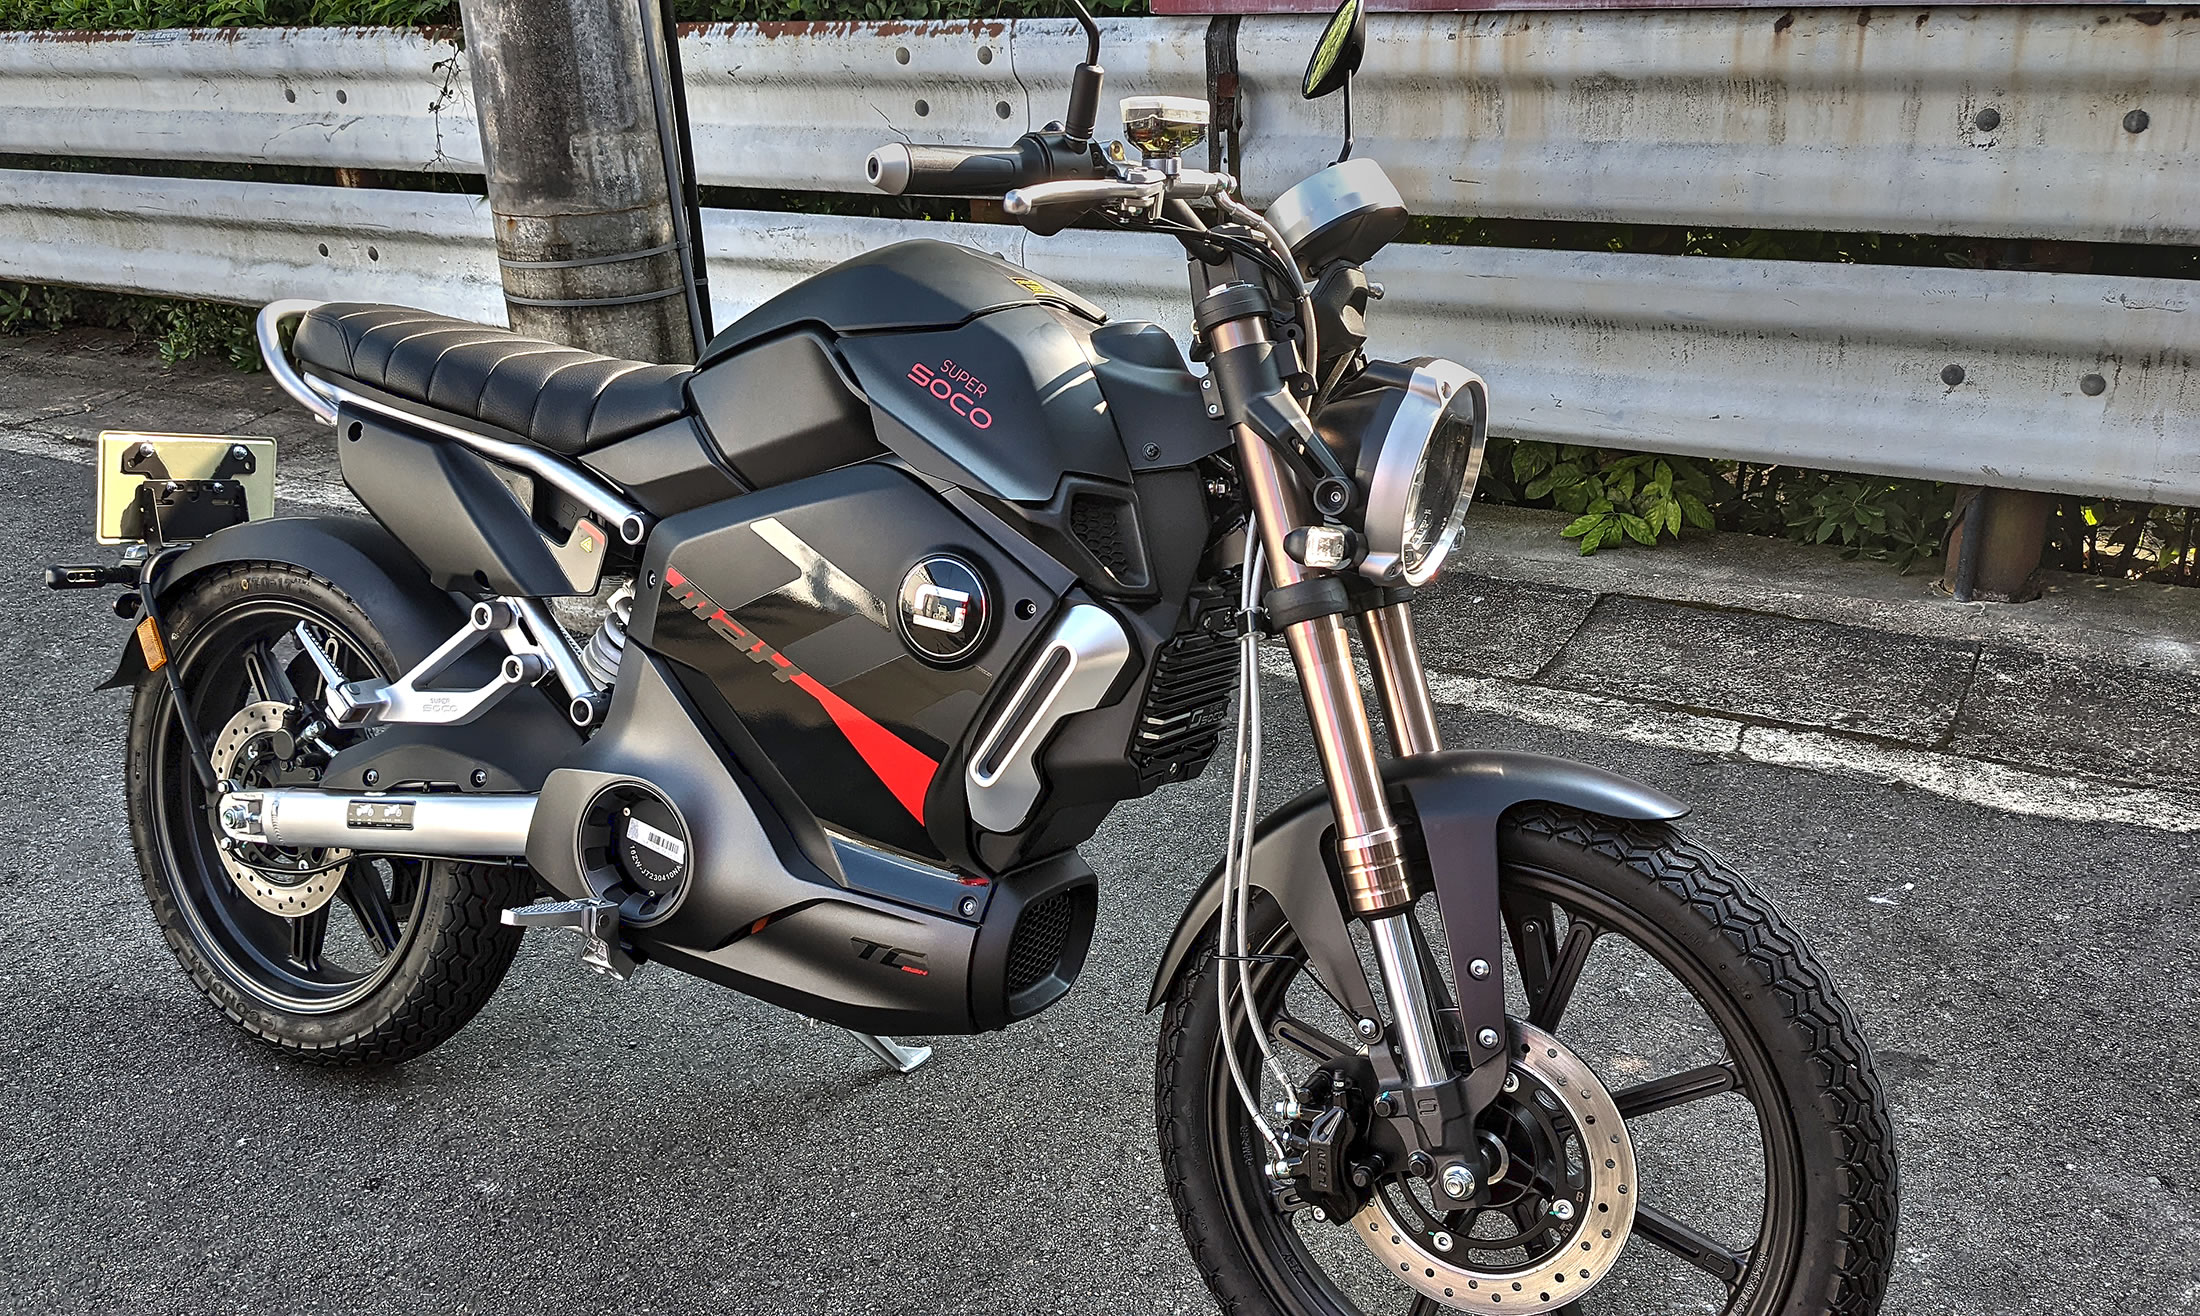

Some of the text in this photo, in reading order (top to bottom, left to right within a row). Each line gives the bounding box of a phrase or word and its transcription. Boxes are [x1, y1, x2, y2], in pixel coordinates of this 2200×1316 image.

[907, 362, 993, 430] SOCO
[940, 359, 988, 399] SUPER
[850, 936, 928, 970] TC
